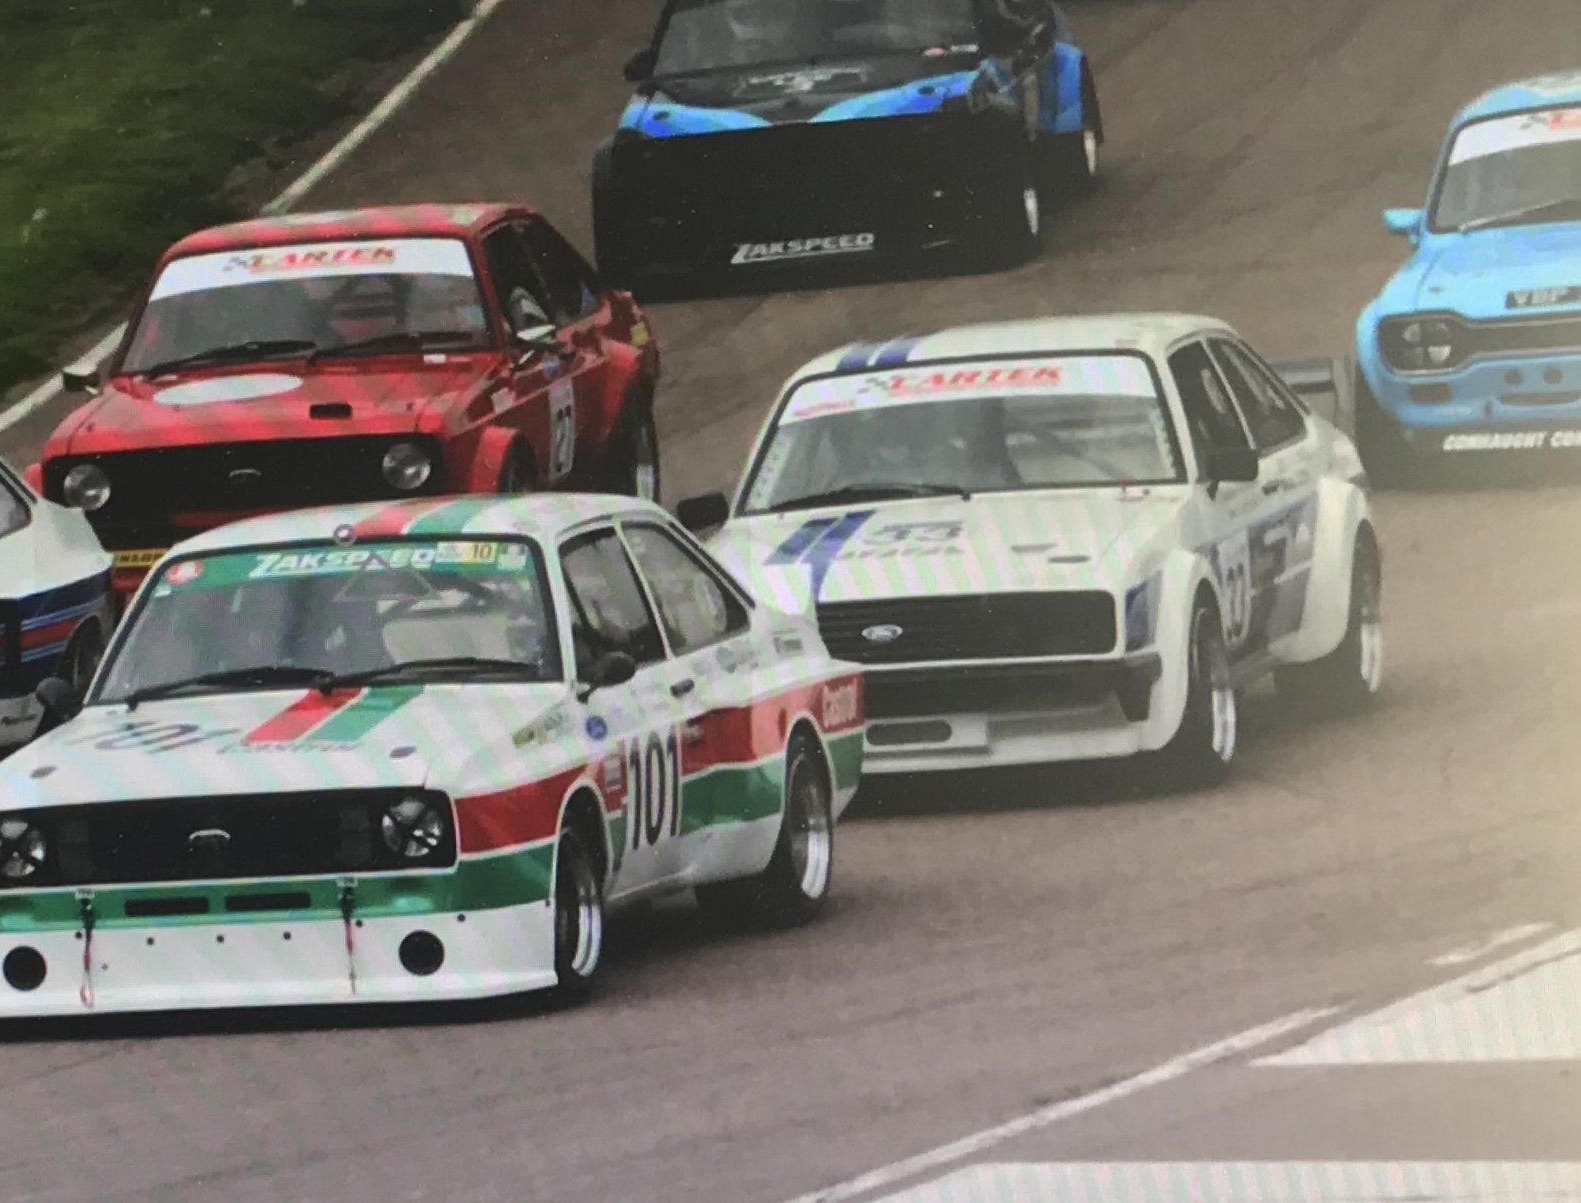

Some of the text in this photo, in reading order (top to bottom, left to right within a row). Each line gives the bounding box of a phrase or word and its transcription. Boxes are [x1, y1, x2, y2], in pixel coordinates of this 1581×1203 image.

[730, 232, 874, 264] ZAKSPEED
[471, 544, 493, 560] 10
[629, 724, 678, 851] 101
